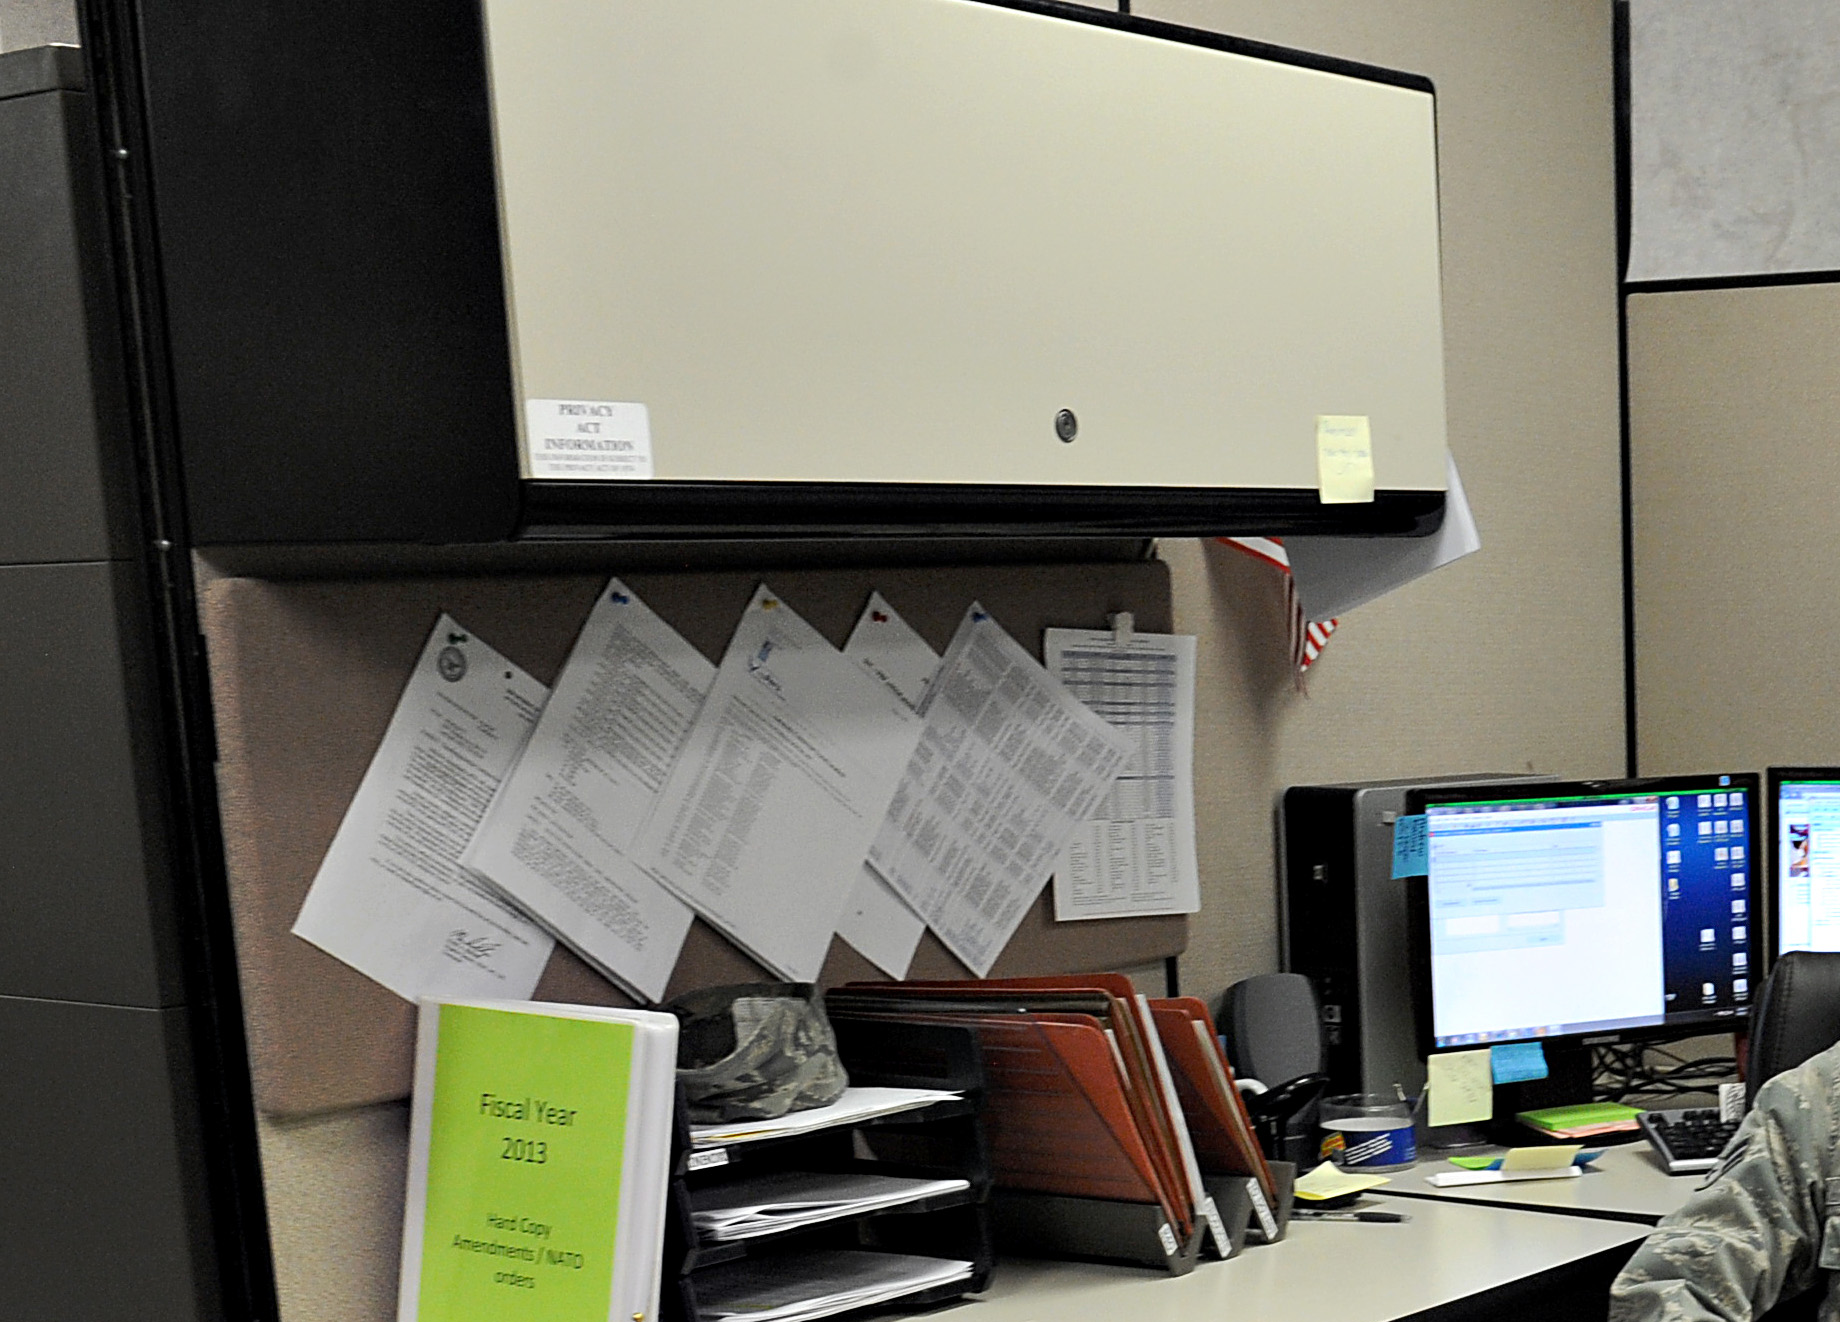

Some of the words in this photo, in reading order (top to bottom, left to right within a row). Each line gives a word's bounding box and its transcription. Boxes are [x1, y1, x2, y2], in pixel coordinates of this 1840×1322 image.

[558, 403, 614, 418] PRIVACY
[576, 421, 602, 434] ACT
[544, 437, 635, 452] INFORMATION
[480, 1092, 531, 1121] Fiscal
[534, 1099, 578, 1127] Year
[501, 1136, 548, 1165] 2013
[486, 1212, 518, 1232] Hard
[519, 1216, 553, 1240] Copy
[451, 1233, 535, 1262] Amendments
[546, 1249, 585, 1270] NATO
[493, 1271, 536, 1289] orders
